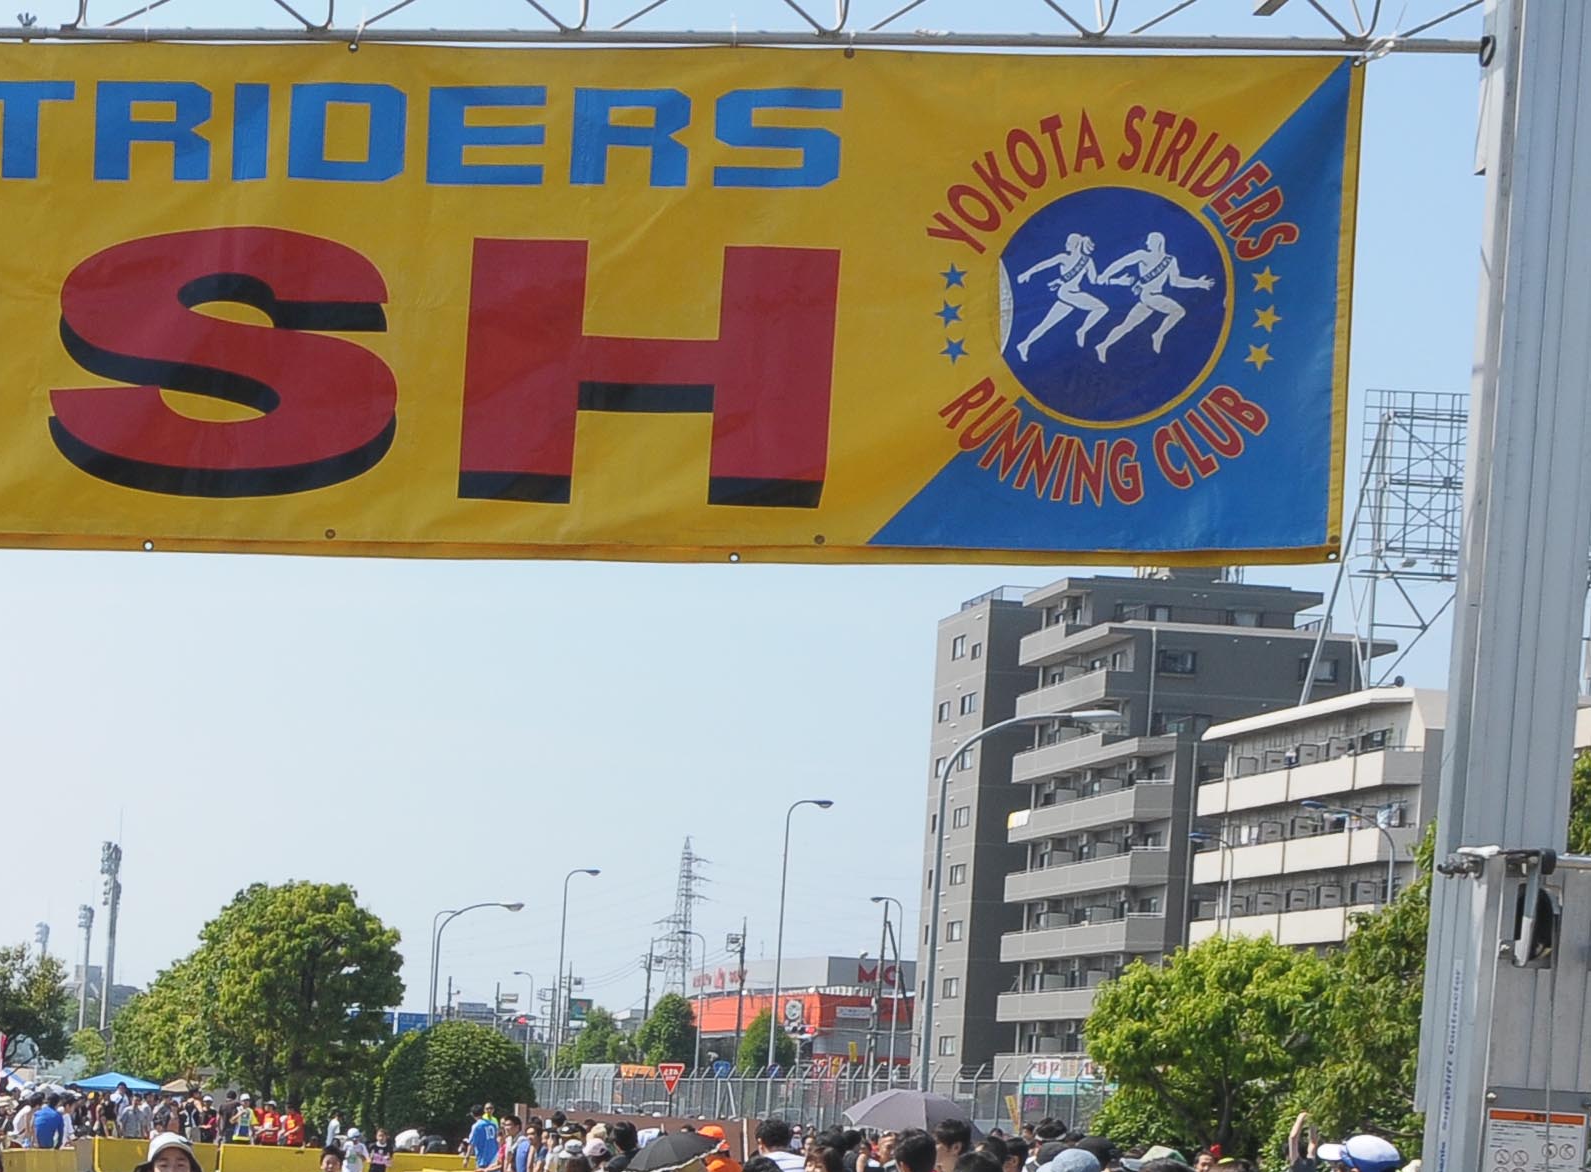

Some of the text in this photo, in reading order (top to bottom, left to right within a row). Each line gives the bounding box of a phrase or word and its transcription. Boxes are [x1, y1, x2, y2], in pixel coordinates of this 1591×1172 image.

[927, 104, 1302, 262] YOKOTA STRIDERS
[938, 376, 1271, 507] RUNNING CLUB
